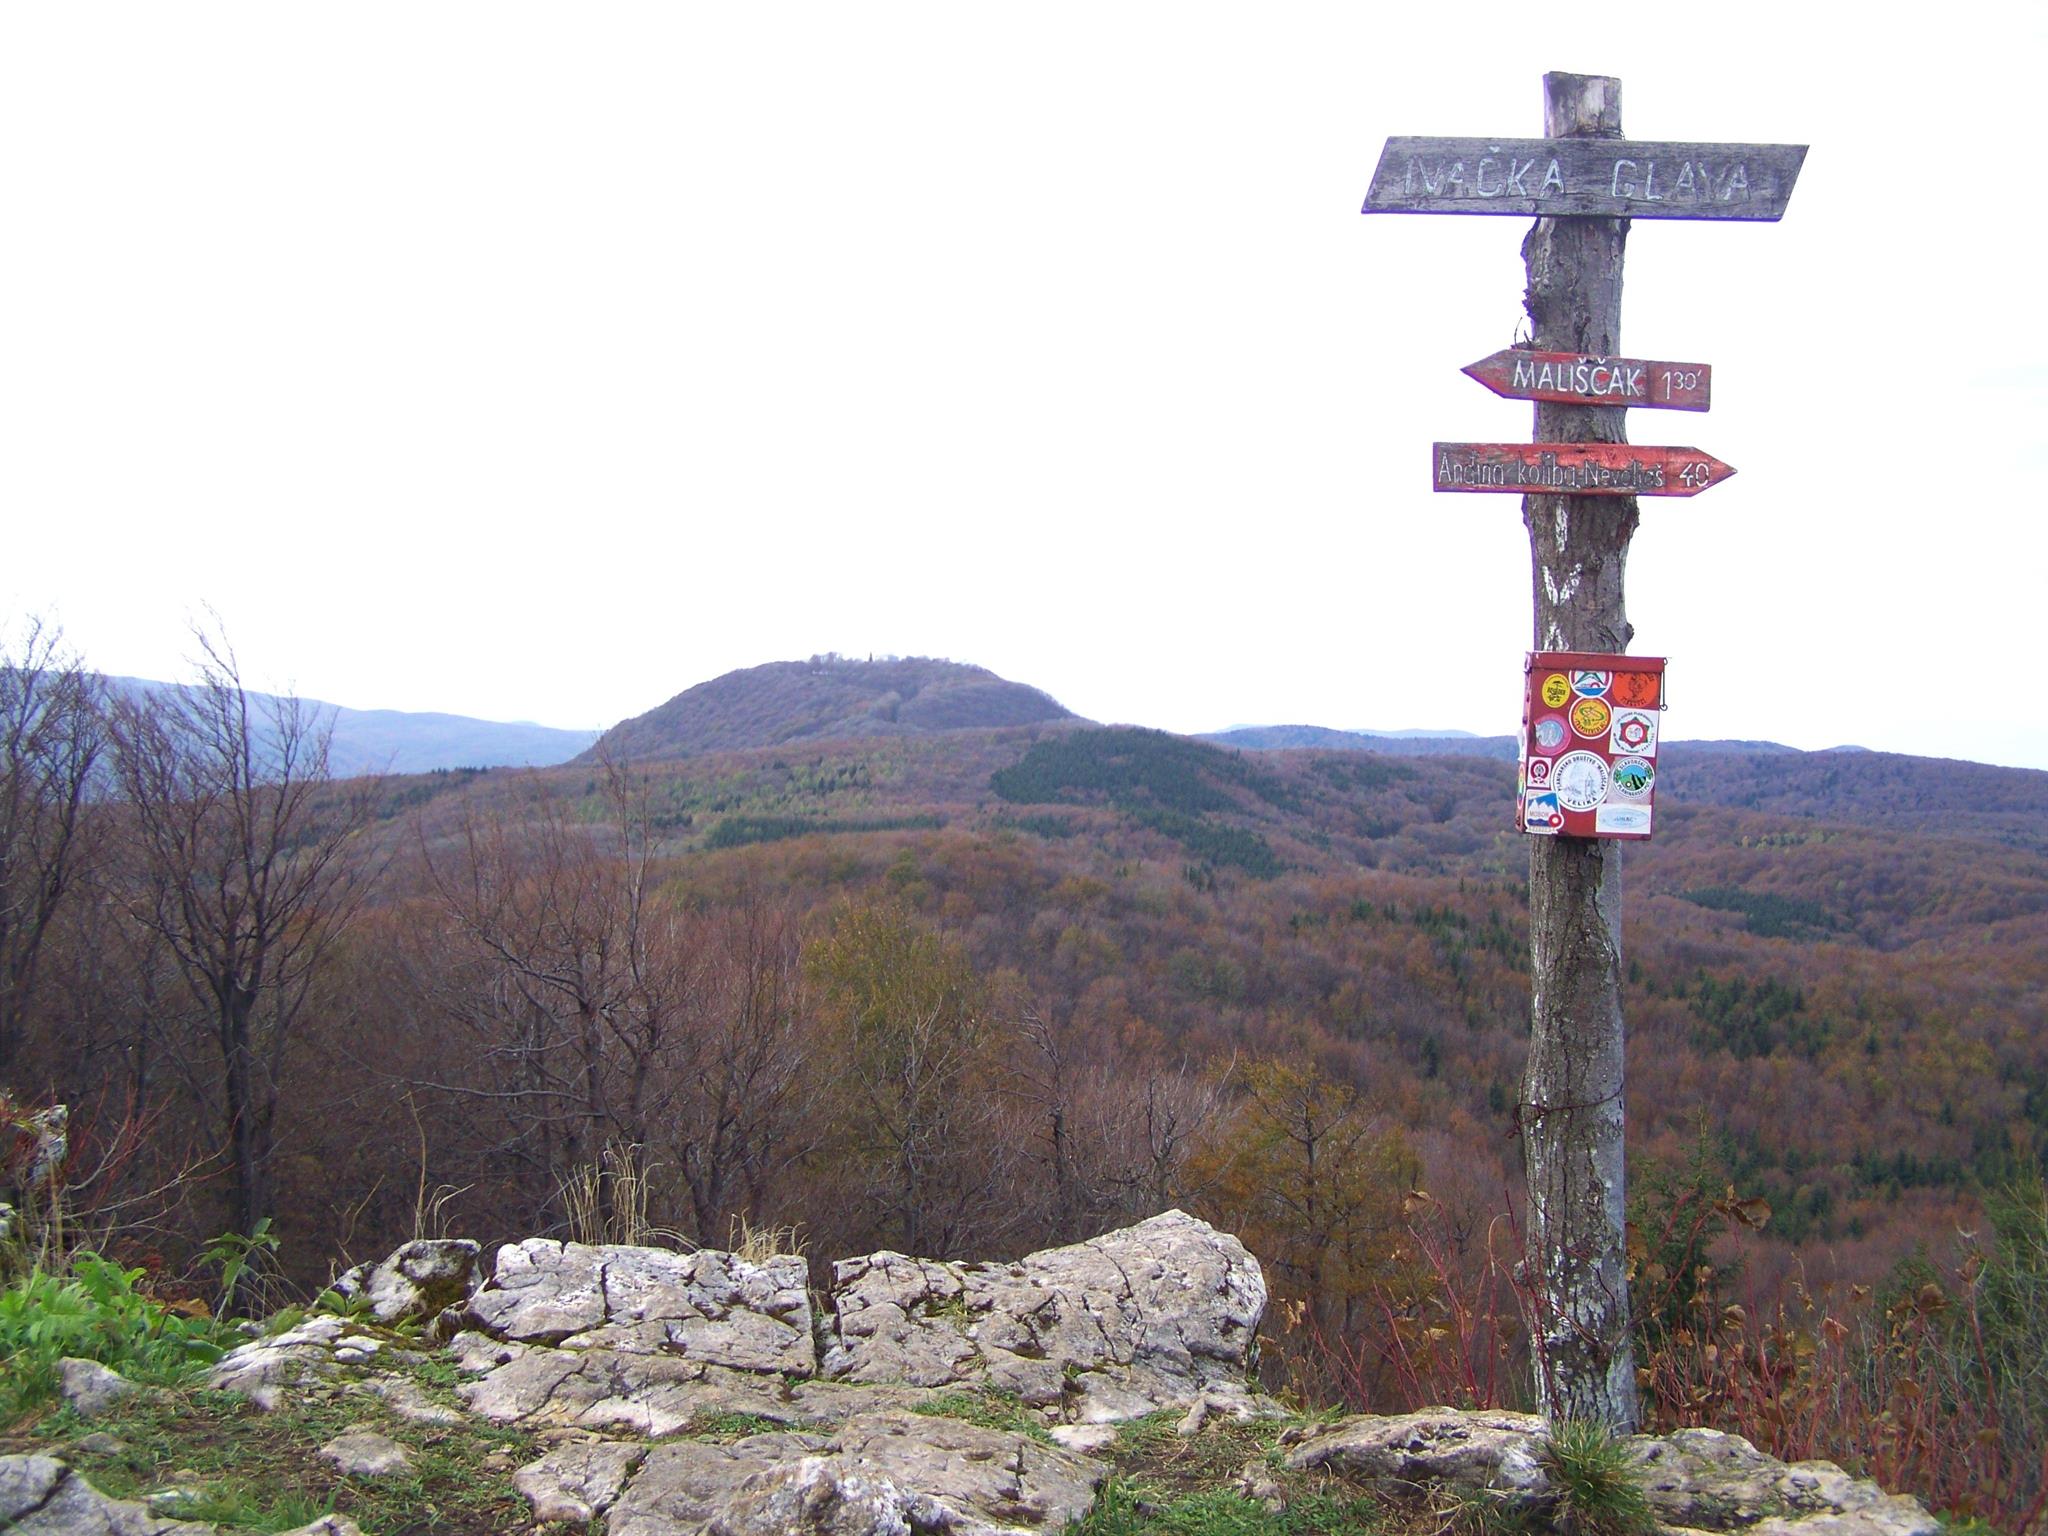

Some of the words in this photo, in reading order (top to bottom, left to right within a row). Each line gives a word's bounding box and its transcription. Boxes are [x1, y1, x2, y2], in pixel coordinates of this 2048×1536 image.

[1403, 146, 1566, 198] IVAČKA
[1612, 158, 1752, 200] GLAVA
[1513, 357, 1641, 397] MALIŠČAK
[1679, 462, 1710, 487] 40
[1567, 796, 1598, 806] VELIKA
